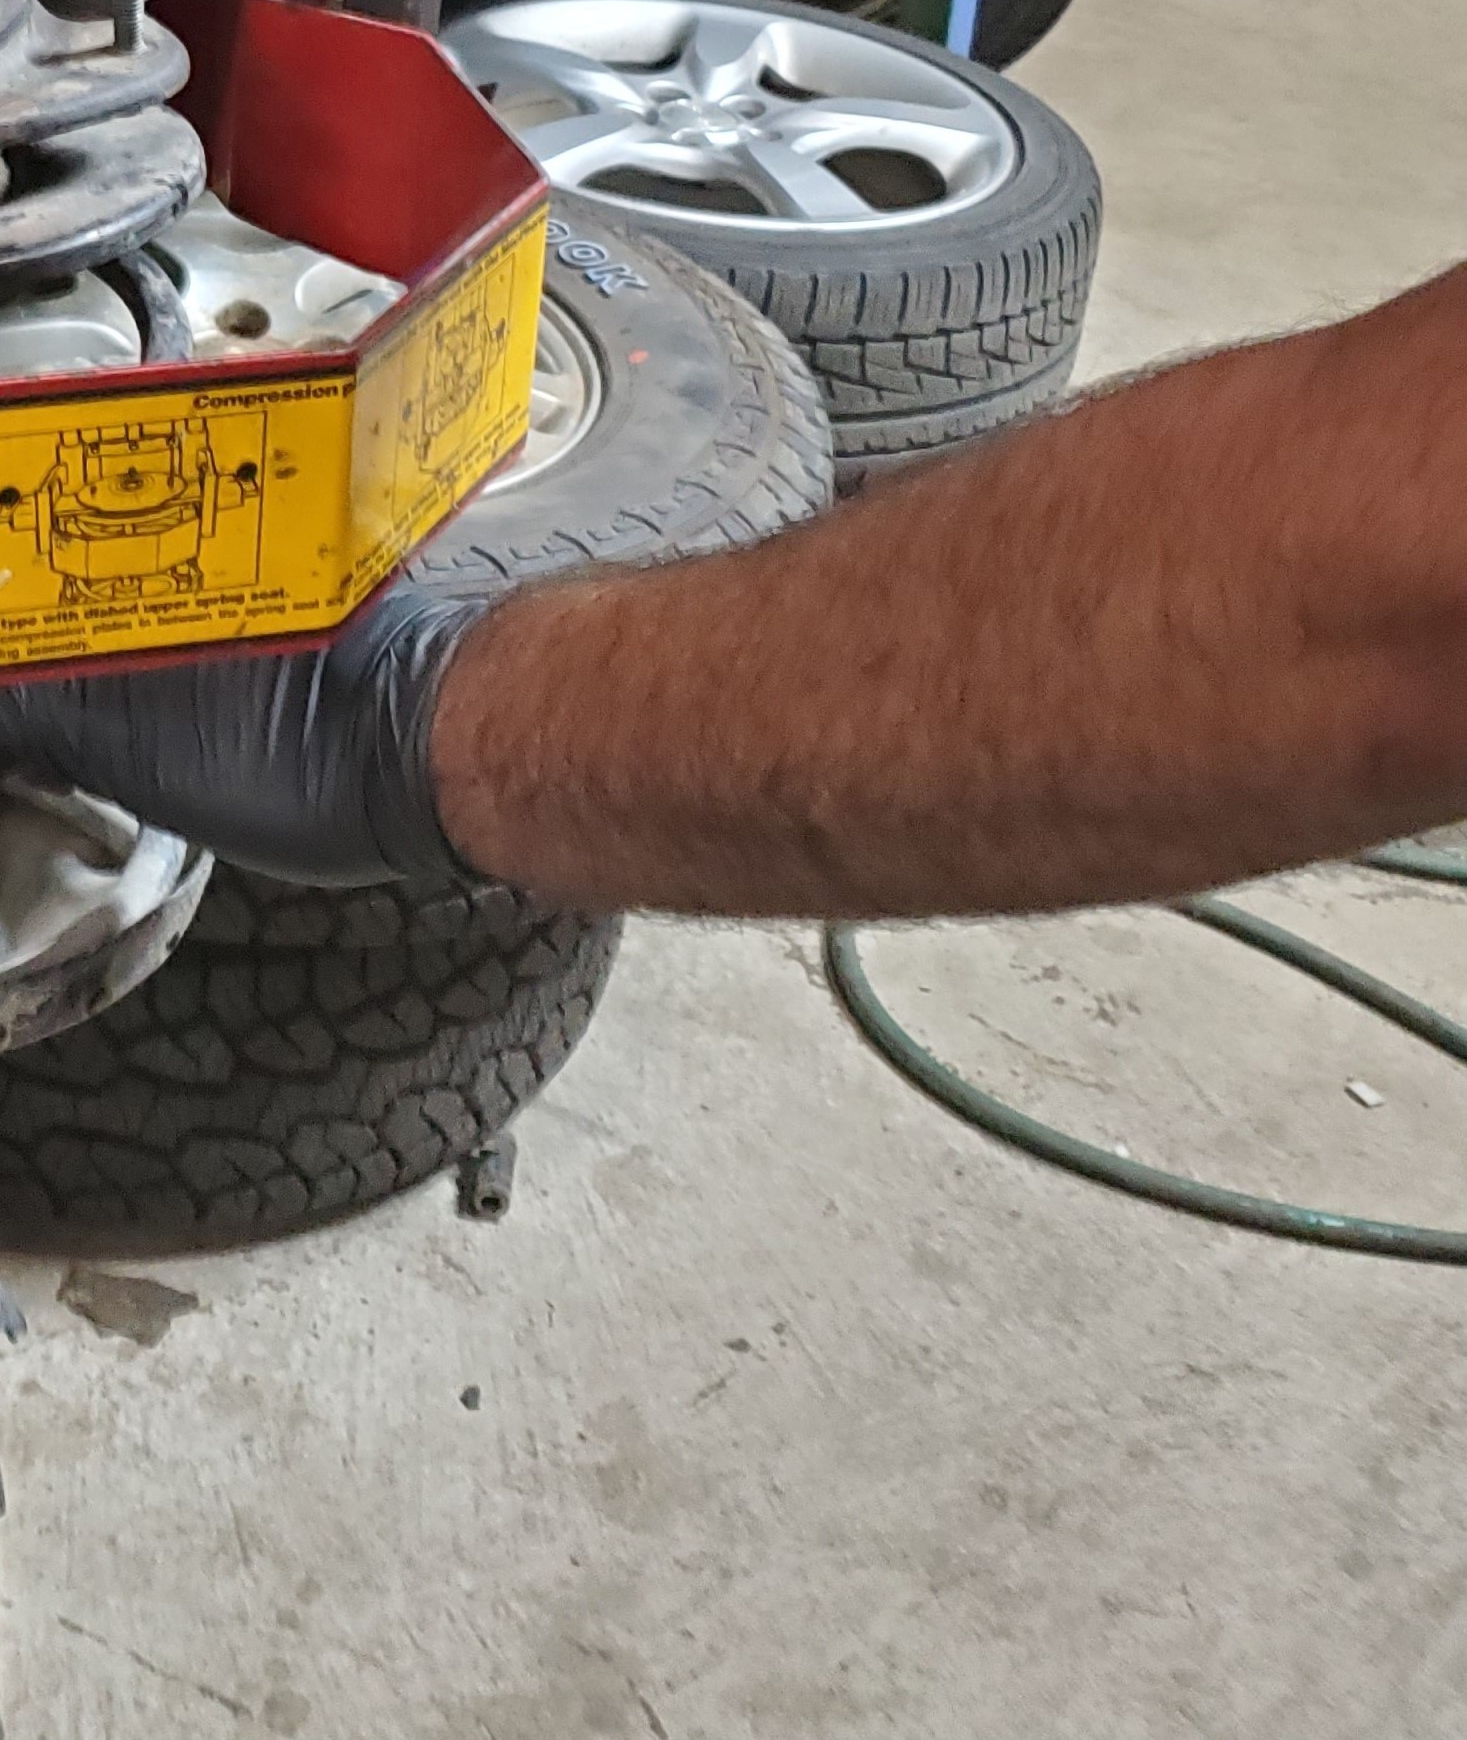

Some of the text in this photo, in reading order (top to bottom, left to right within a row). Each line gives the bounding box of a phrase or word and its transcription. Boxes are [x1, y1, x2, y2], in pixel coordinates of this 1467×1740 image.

[192, 383, 339, 410] Compression
[1, 615, 37, 631] type
[43, 610, 79, 626] with
